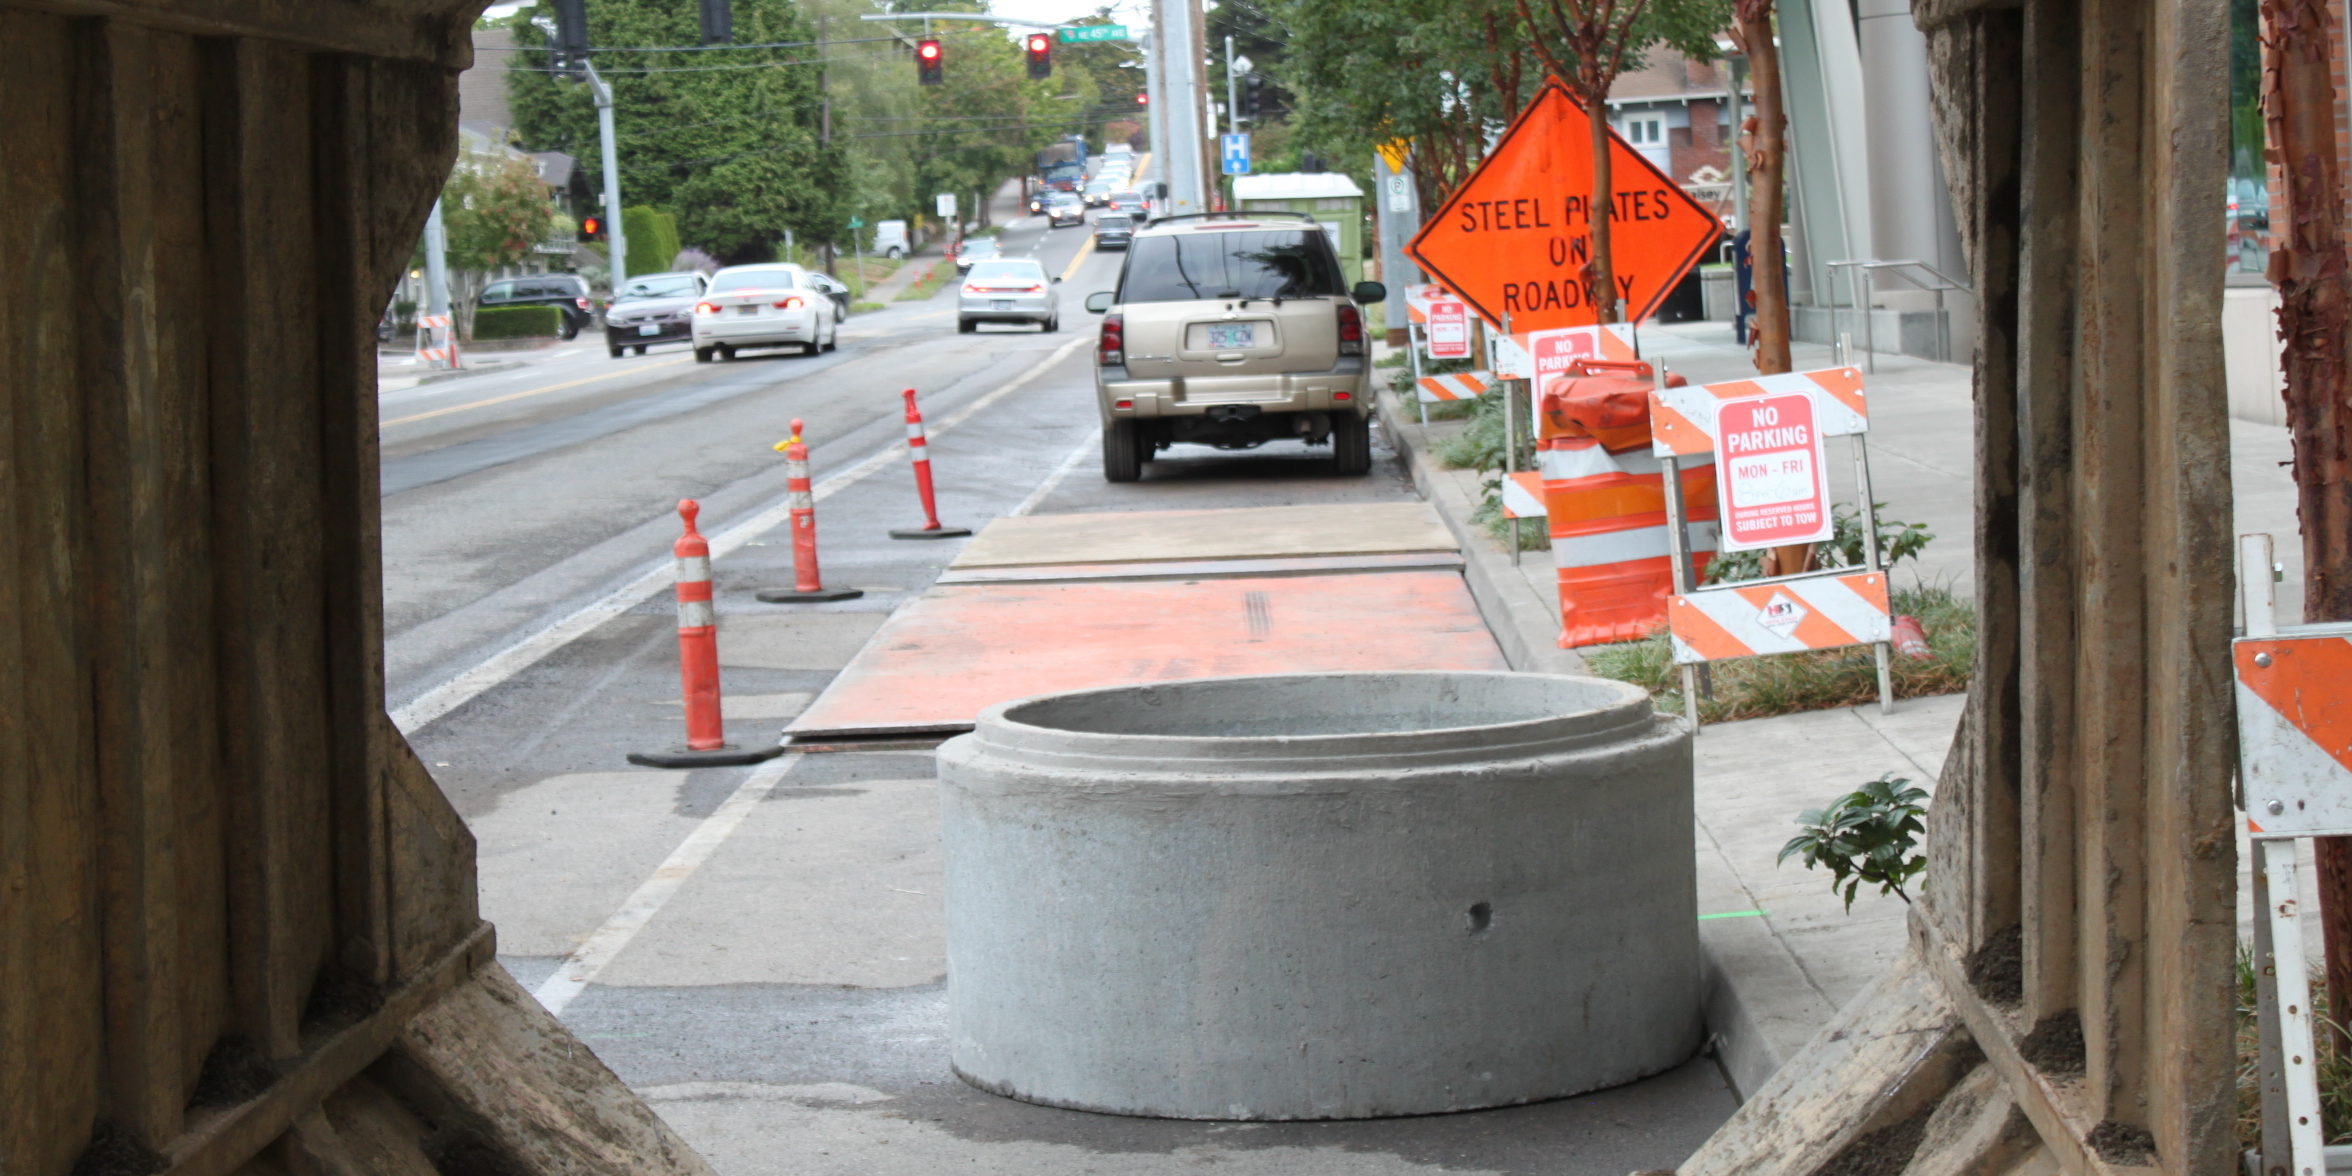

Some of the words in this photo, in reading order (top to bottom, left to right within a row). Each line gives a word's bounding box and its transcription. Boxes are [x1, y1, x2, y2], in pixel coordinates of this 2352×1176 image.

[1225, 136, 1245, 160] H
[1461, 198, 1550, 232] STEEL
[1549, 235, 1587, 266] ON
[1504, 275, 1635, 313] ROADWY
[1554, 339, 1573, 354] NO
[1751, 406, 1778, 427] NO
[1727, 424, 1808, 453] PARKING
[1738, 464, 1768, 480] MON
[1782, 459, 1804, 475] FRI
[1735, 516, 1778, 532] SUBJECT
[1780, 514, 1793, 526] TO
[1795, 512, 1817, 525] TOW
